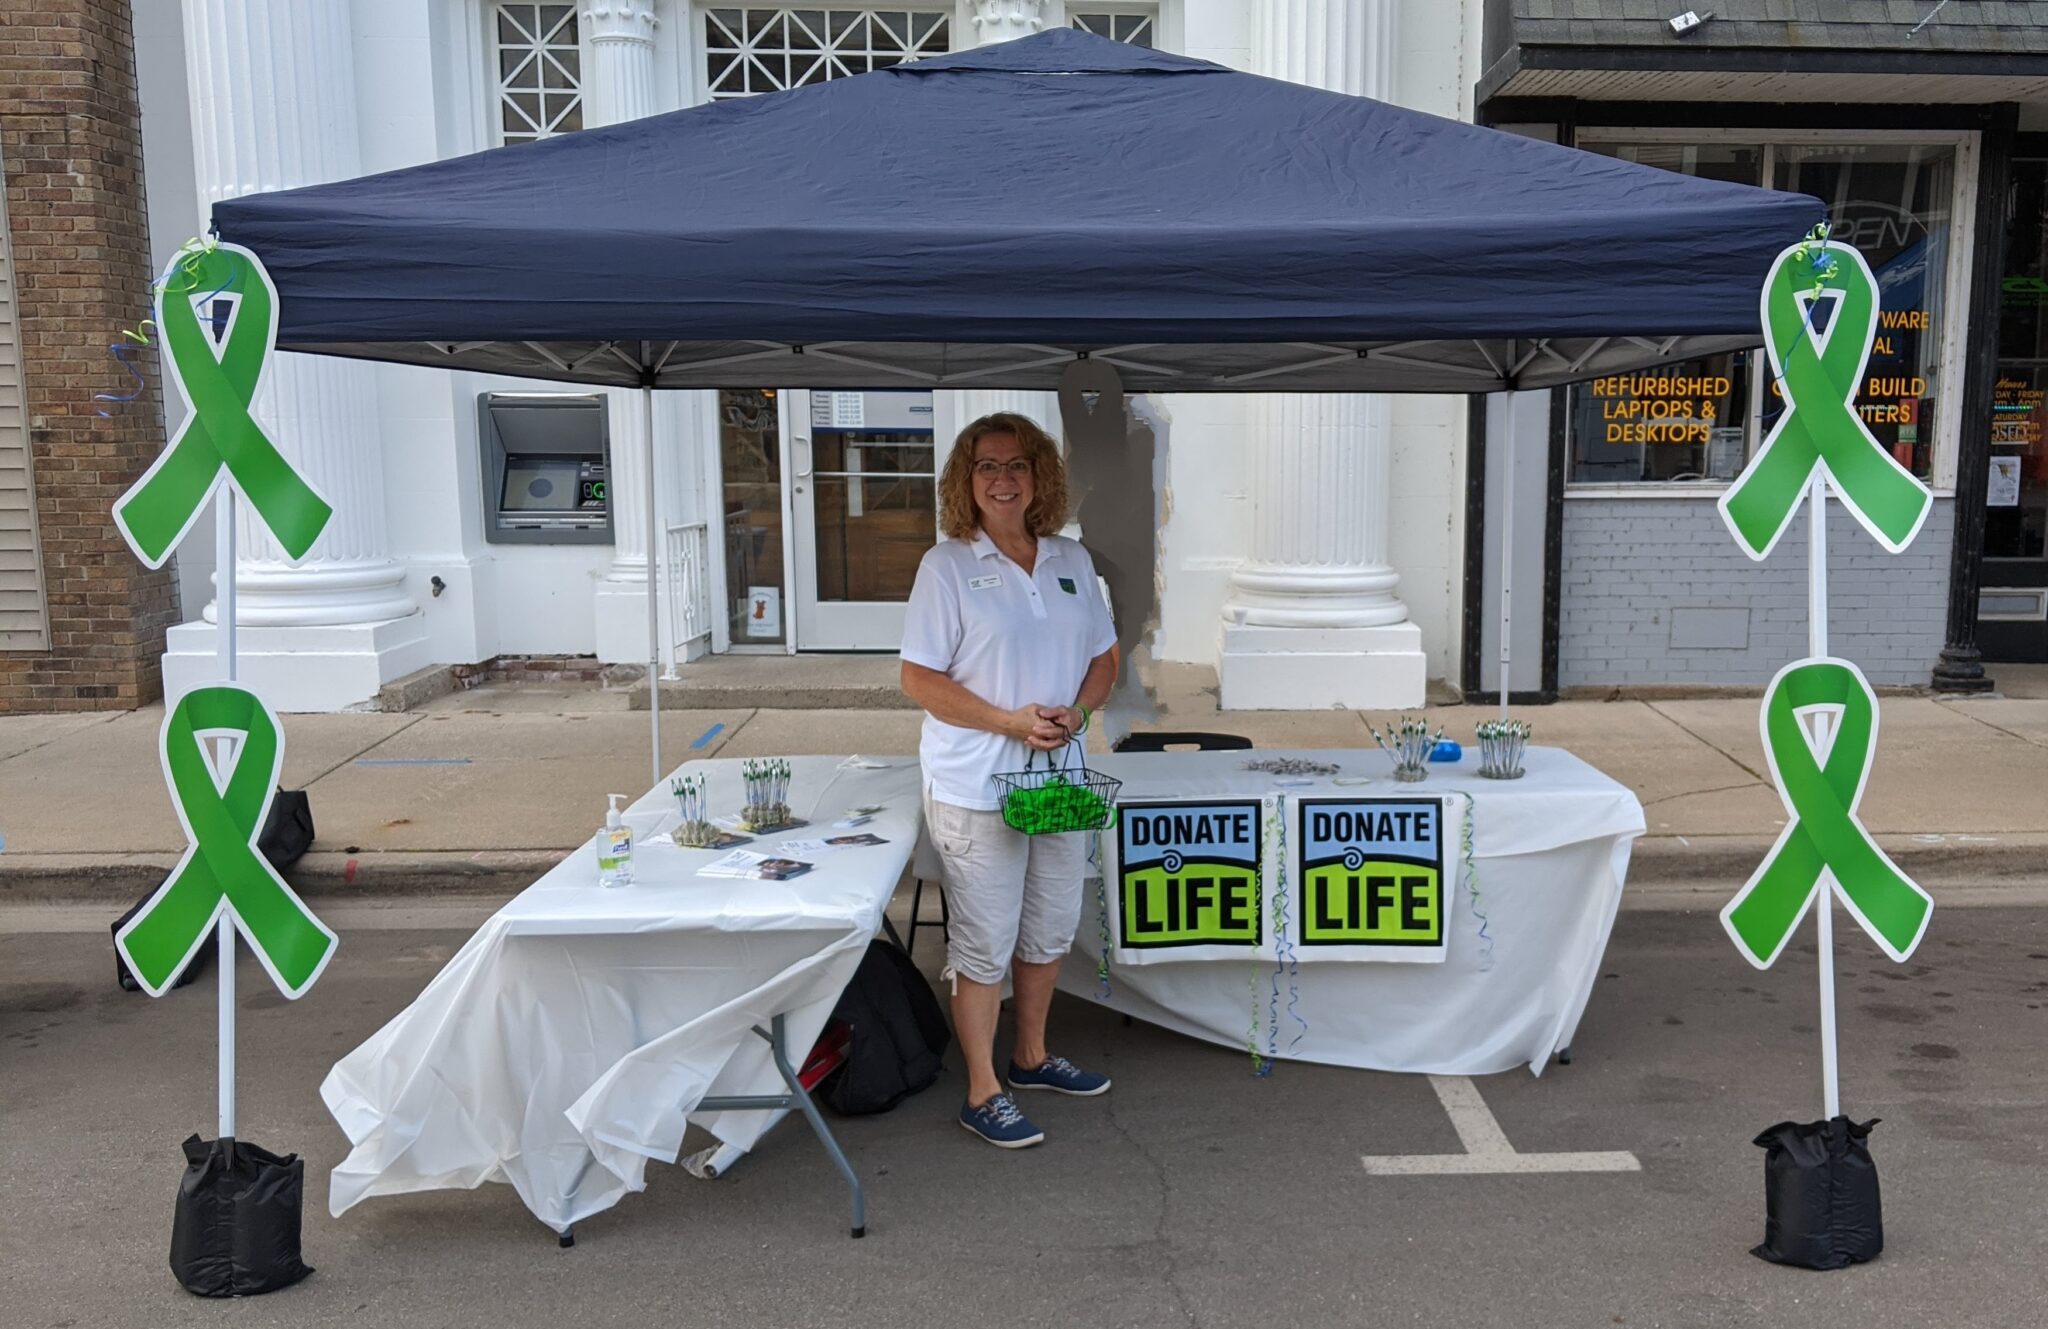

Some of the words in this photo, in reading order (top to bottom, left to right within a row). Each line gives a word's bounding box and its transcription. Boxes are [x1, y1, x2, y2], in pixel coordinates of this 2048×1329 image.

[1833, 216, 1914, 250] PEN
[1880, 311, 1930, 329] WARE
[1873, 336, 1895, 355] AL
[1592, 377, 1730, 397] REFURBISHED
[1869, 377, 1926, 397] BUILD
[1995, 390, 2011, 399] DAY
[1603, 400, 1693, 419] LAPTOPS
[1701, 400, 1717, 419] &
[1993, 413, 2028, 421] ATURDAY
[1606, 423, 1712, 442] DESKTOPS
[1131, 813, 1250, 846] DONATE
[1312, 811, 1431, 843] DONATE
[1134, 876, 1249, 933] LIFE
[1315, 875, 1431, 930] LIFE
